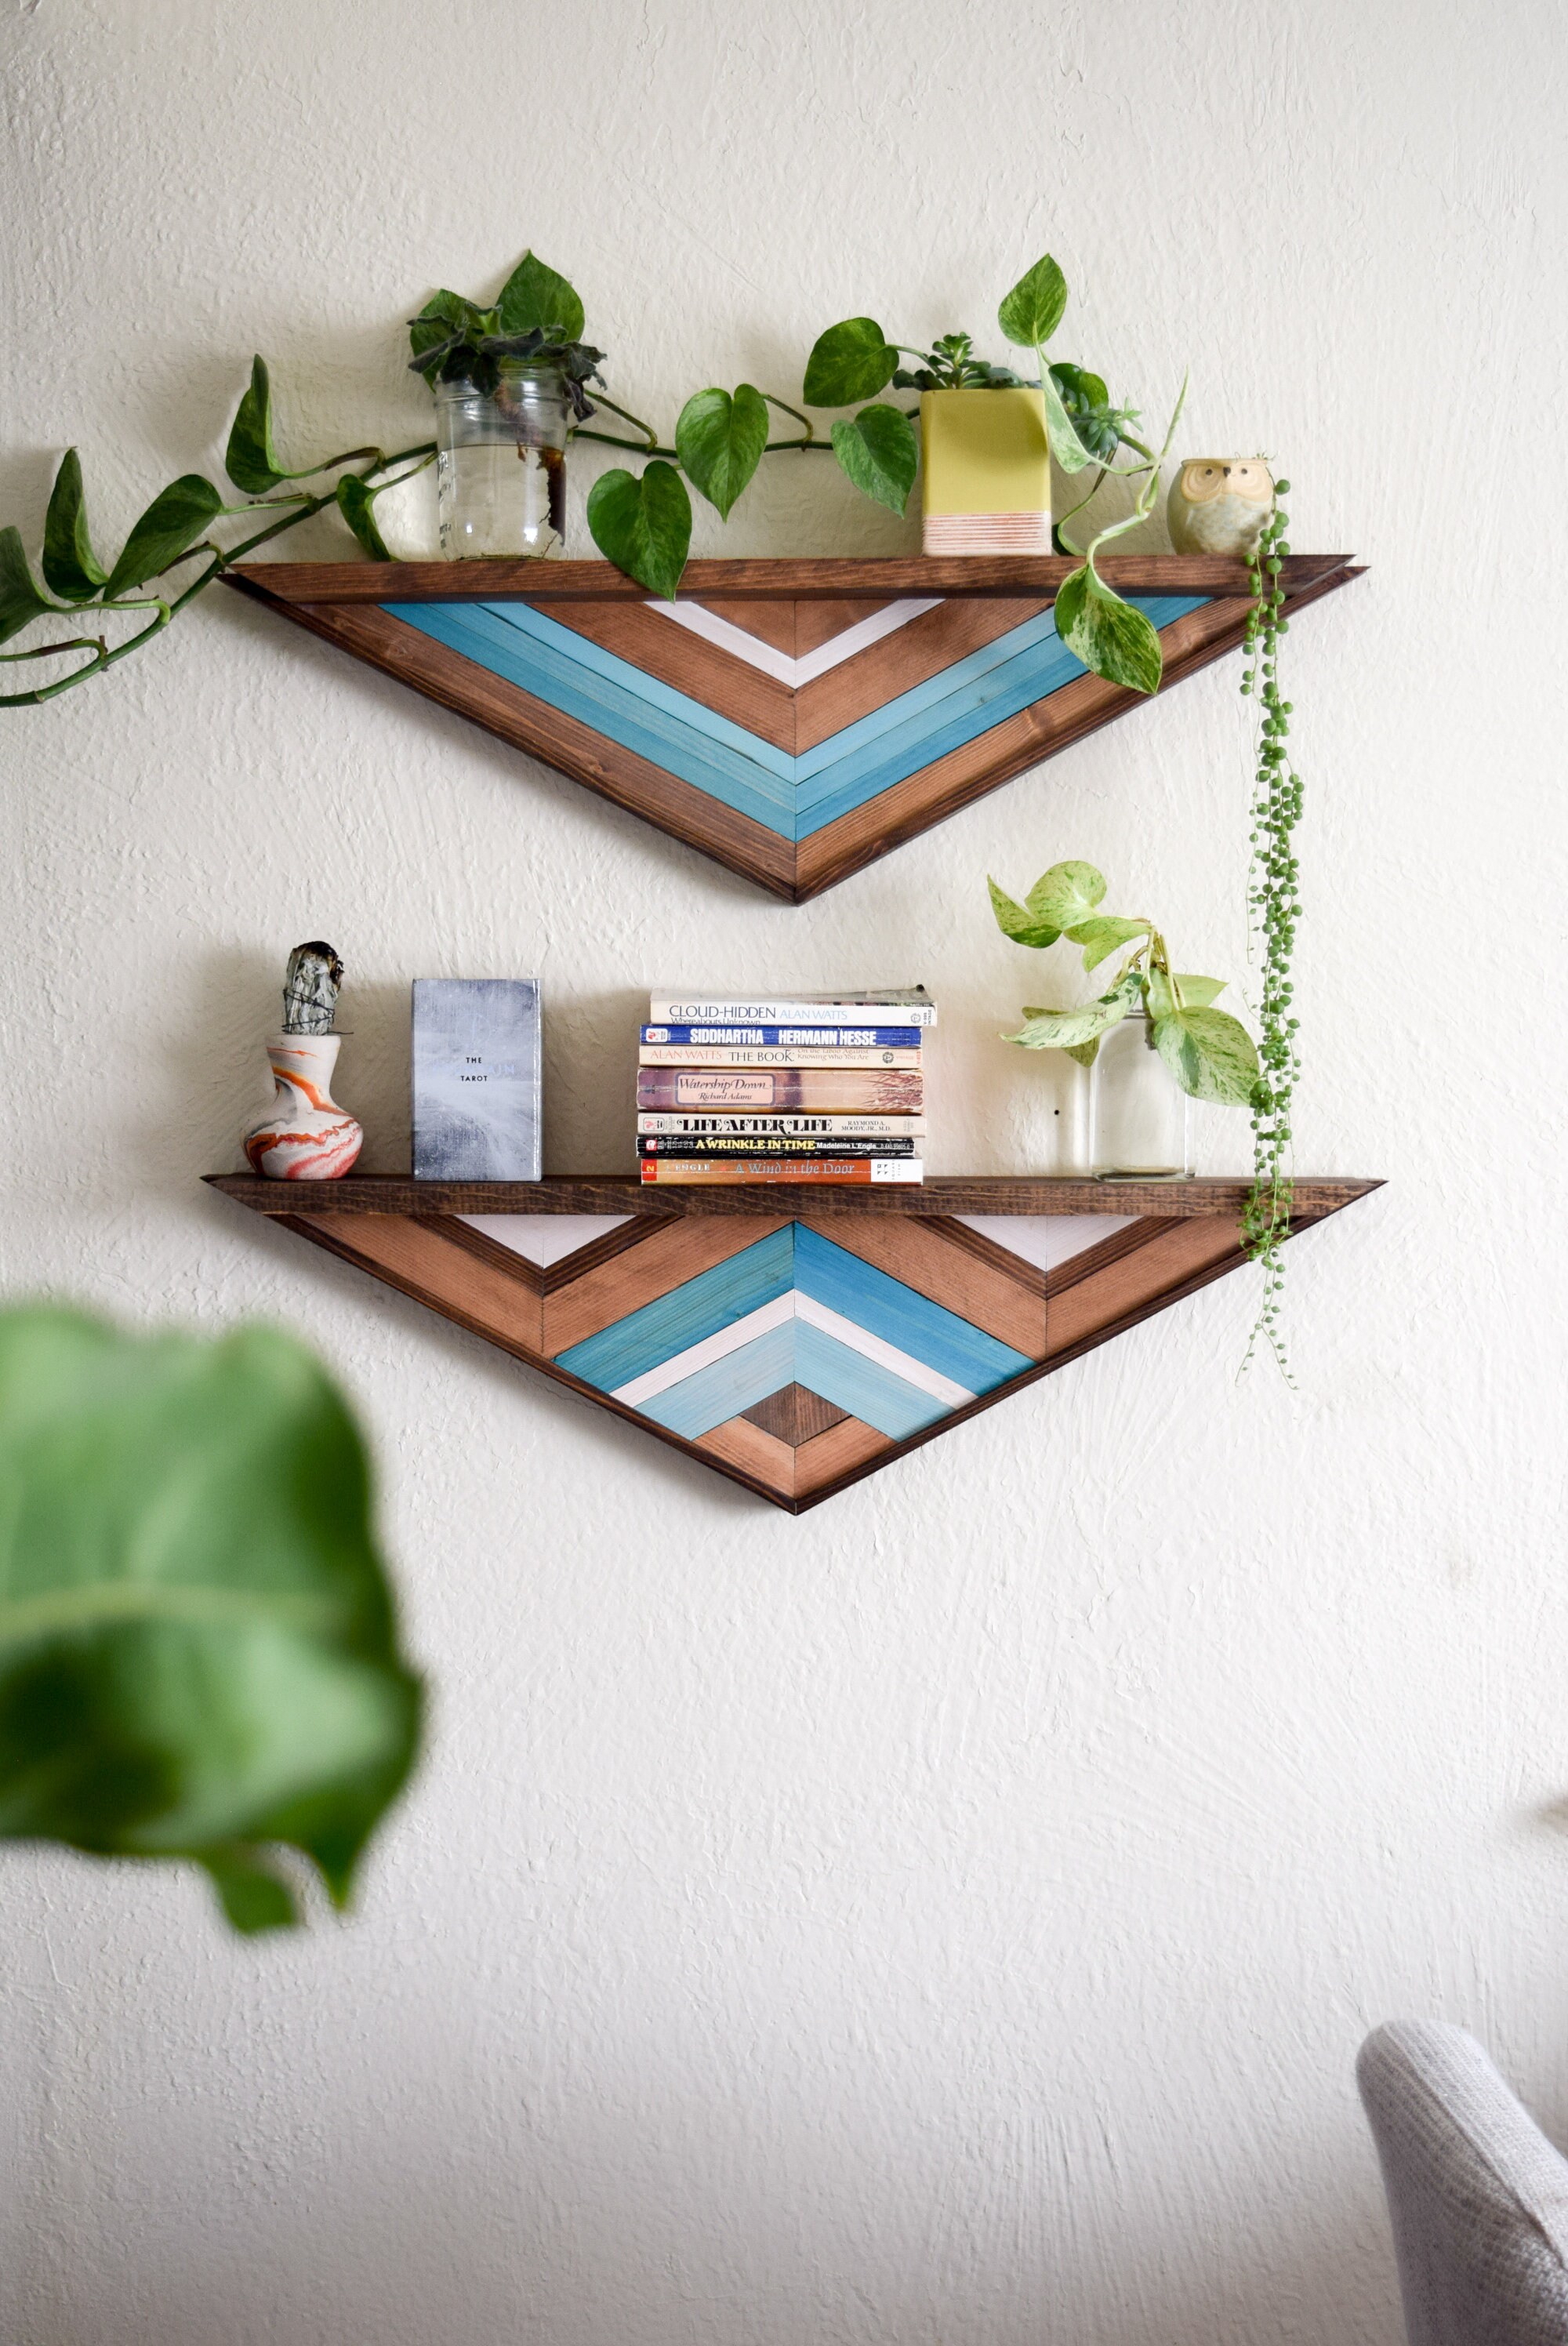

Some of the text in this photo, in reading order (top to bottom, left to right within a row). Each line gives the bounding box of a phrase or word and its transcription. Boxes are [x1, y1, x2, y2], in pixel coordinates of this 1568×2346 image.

[669, 1005, 848, 1020] CLOUD-HIDDEN ALAN WATTS
[690, 1028, 764, 1044] SIDDHARTHA
[779, 1030, 837, 1045] HERMANN
[839, 1030, 877, 1046] HESSE
[651, 1050, 684, 1059] ALAN
[685, 1050, 722, 1059] WATTS
[728, 1051, 753, 1062] THE
[679, 1078, 768, 1093] Watership Down
[698, 1092, 726, 1101] Richard
[677, 1118, 722, 1131] LIFE
[723, 1119, 790, 1135] AFTER
[786, 1119, 833, 1132] LIFE
[695, 1139, 706, 1149] A
[706, 1139, 765, 1149] WRINKLE
[768, 1140, 783, 1149] IN
[783, 1140, 815, 1150] TIME
[851, 1142, 877, 1151] L'Engle
[735, 1160, 855, 1175] A Wind in the Door
